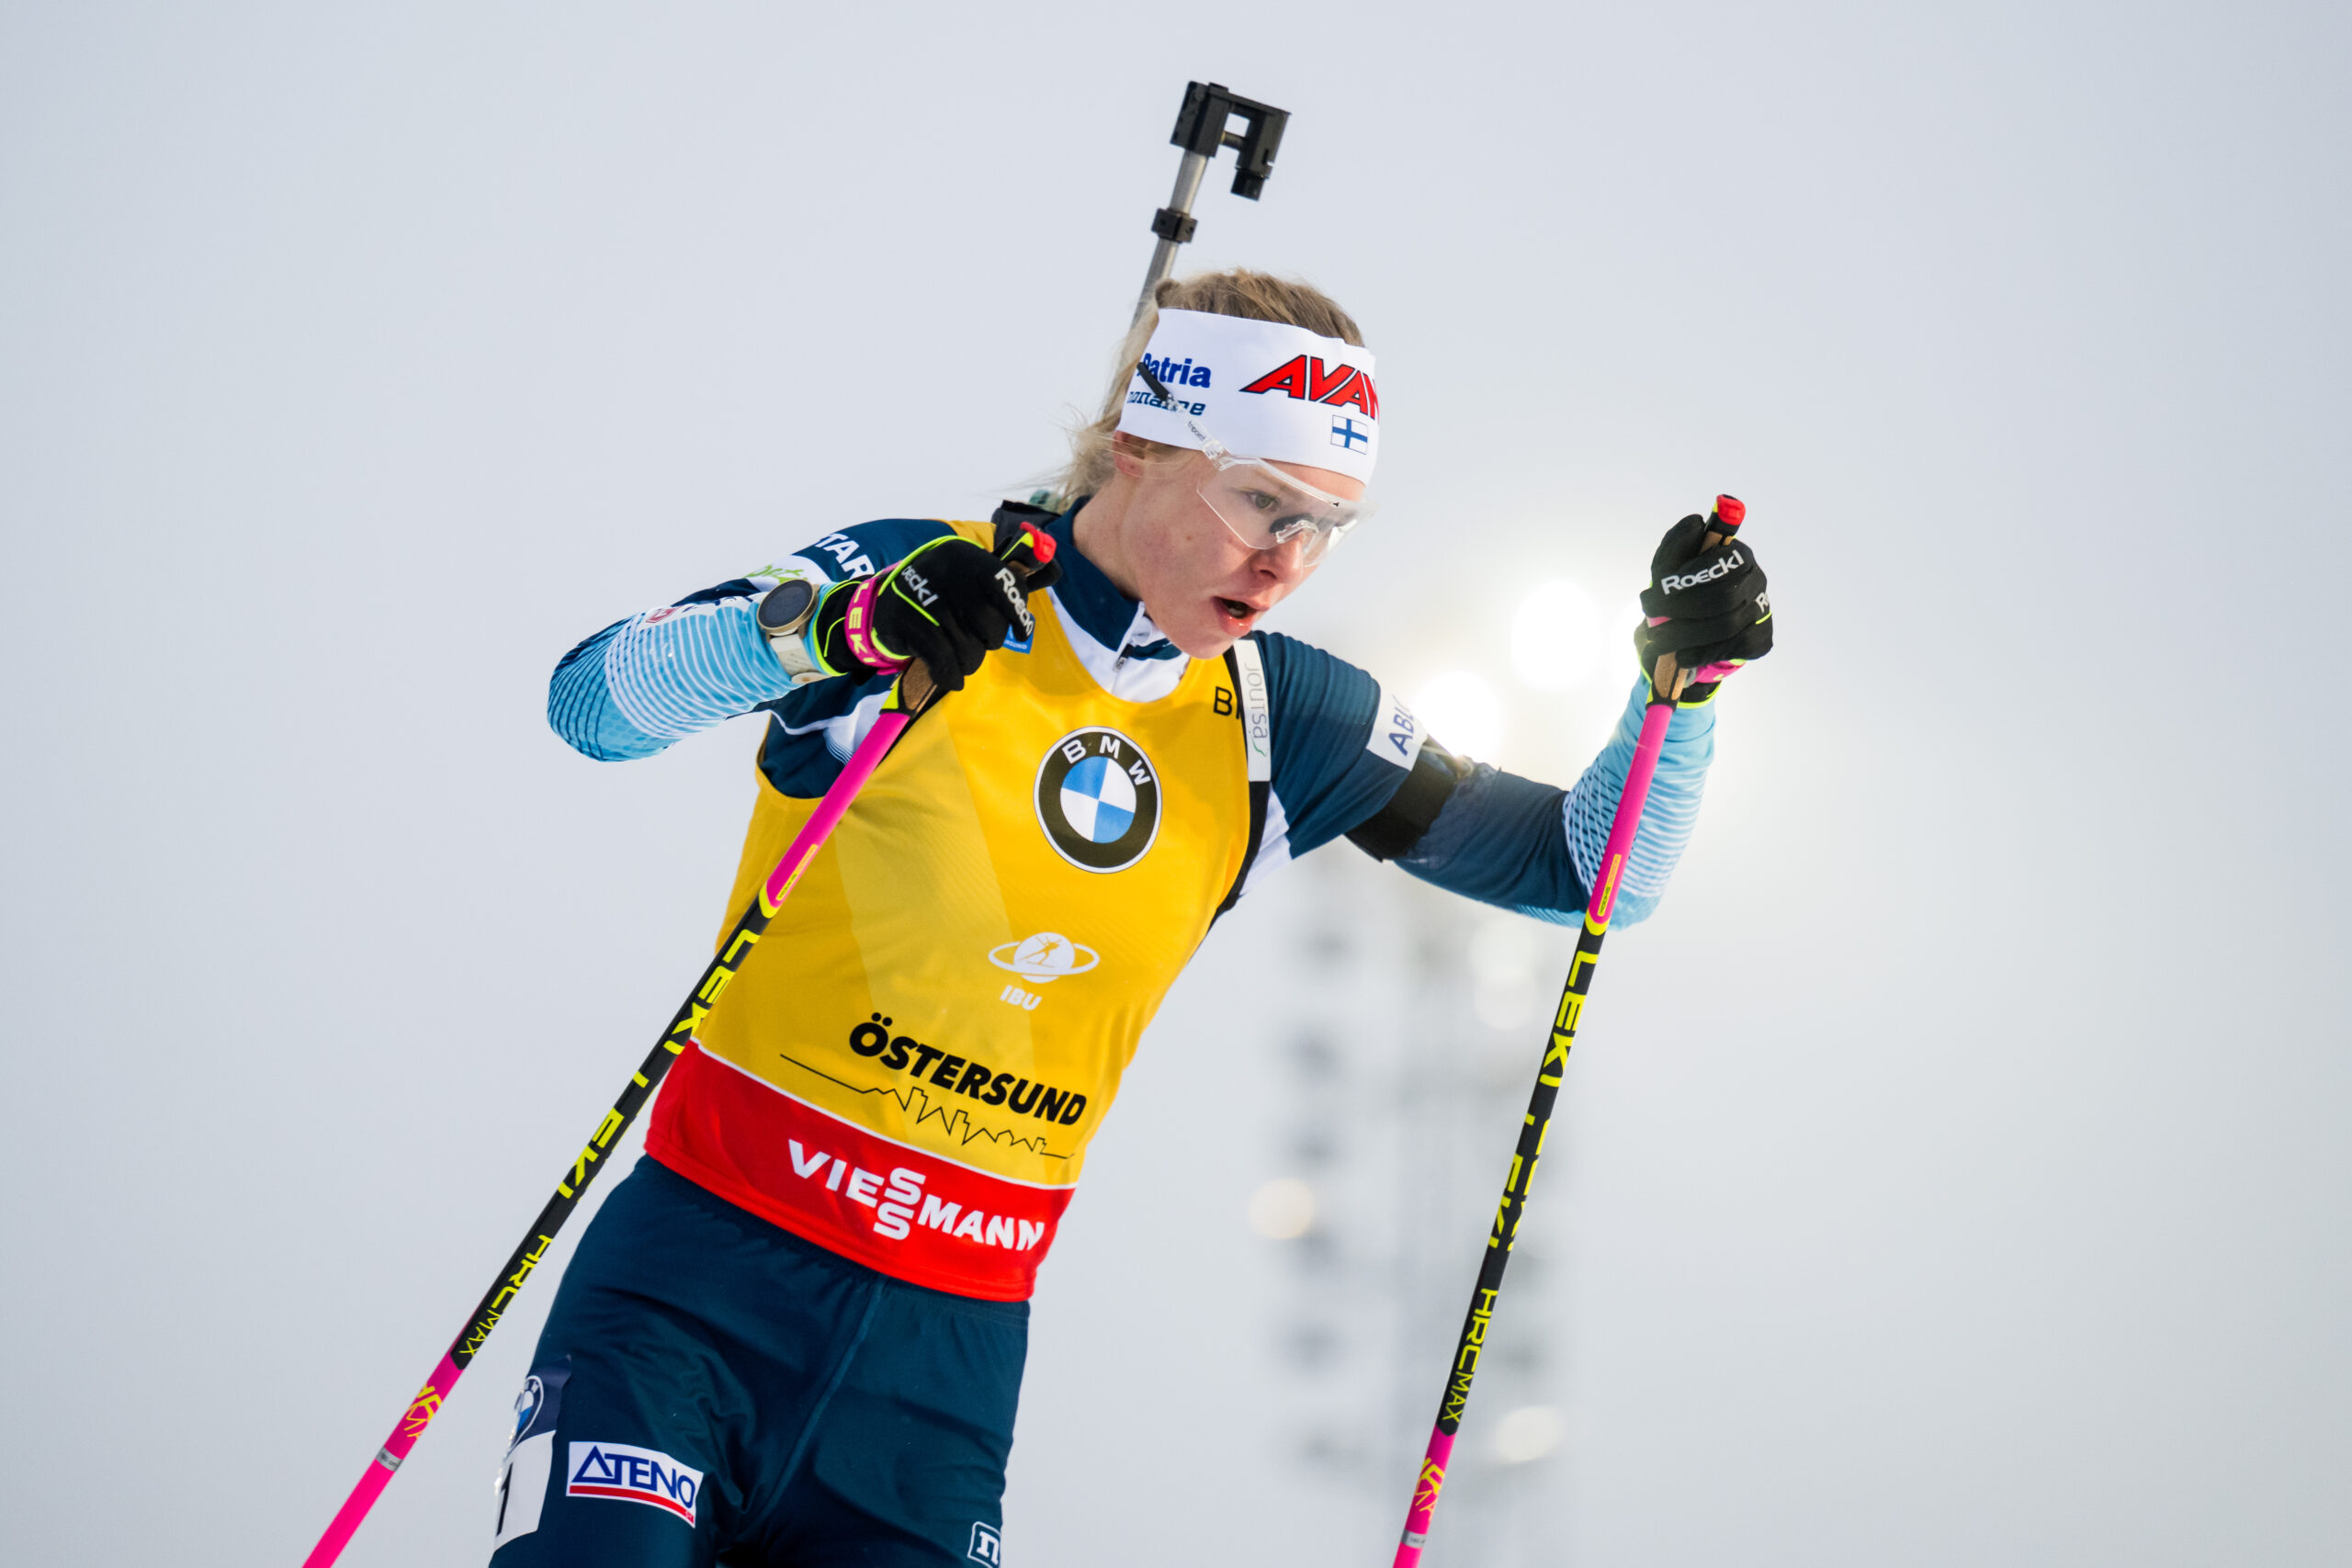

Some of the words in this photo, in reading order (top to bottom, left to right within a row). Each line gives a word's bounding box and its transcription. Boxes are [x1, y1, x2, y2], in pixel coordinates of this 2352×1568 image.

[1660, 549, 1745, 595] Roeckl
[1062, 735, 1151, 786] BMW
[662, 928, 761, 1055] LEKI
[1000, 985, 1043, 1010] IBU
[1539, 950, 1600, 1088] LEKI
[849, 1011, 1087, 1126] ÖSTERSUND
[571, 1445, 695, 1508] ATENO
